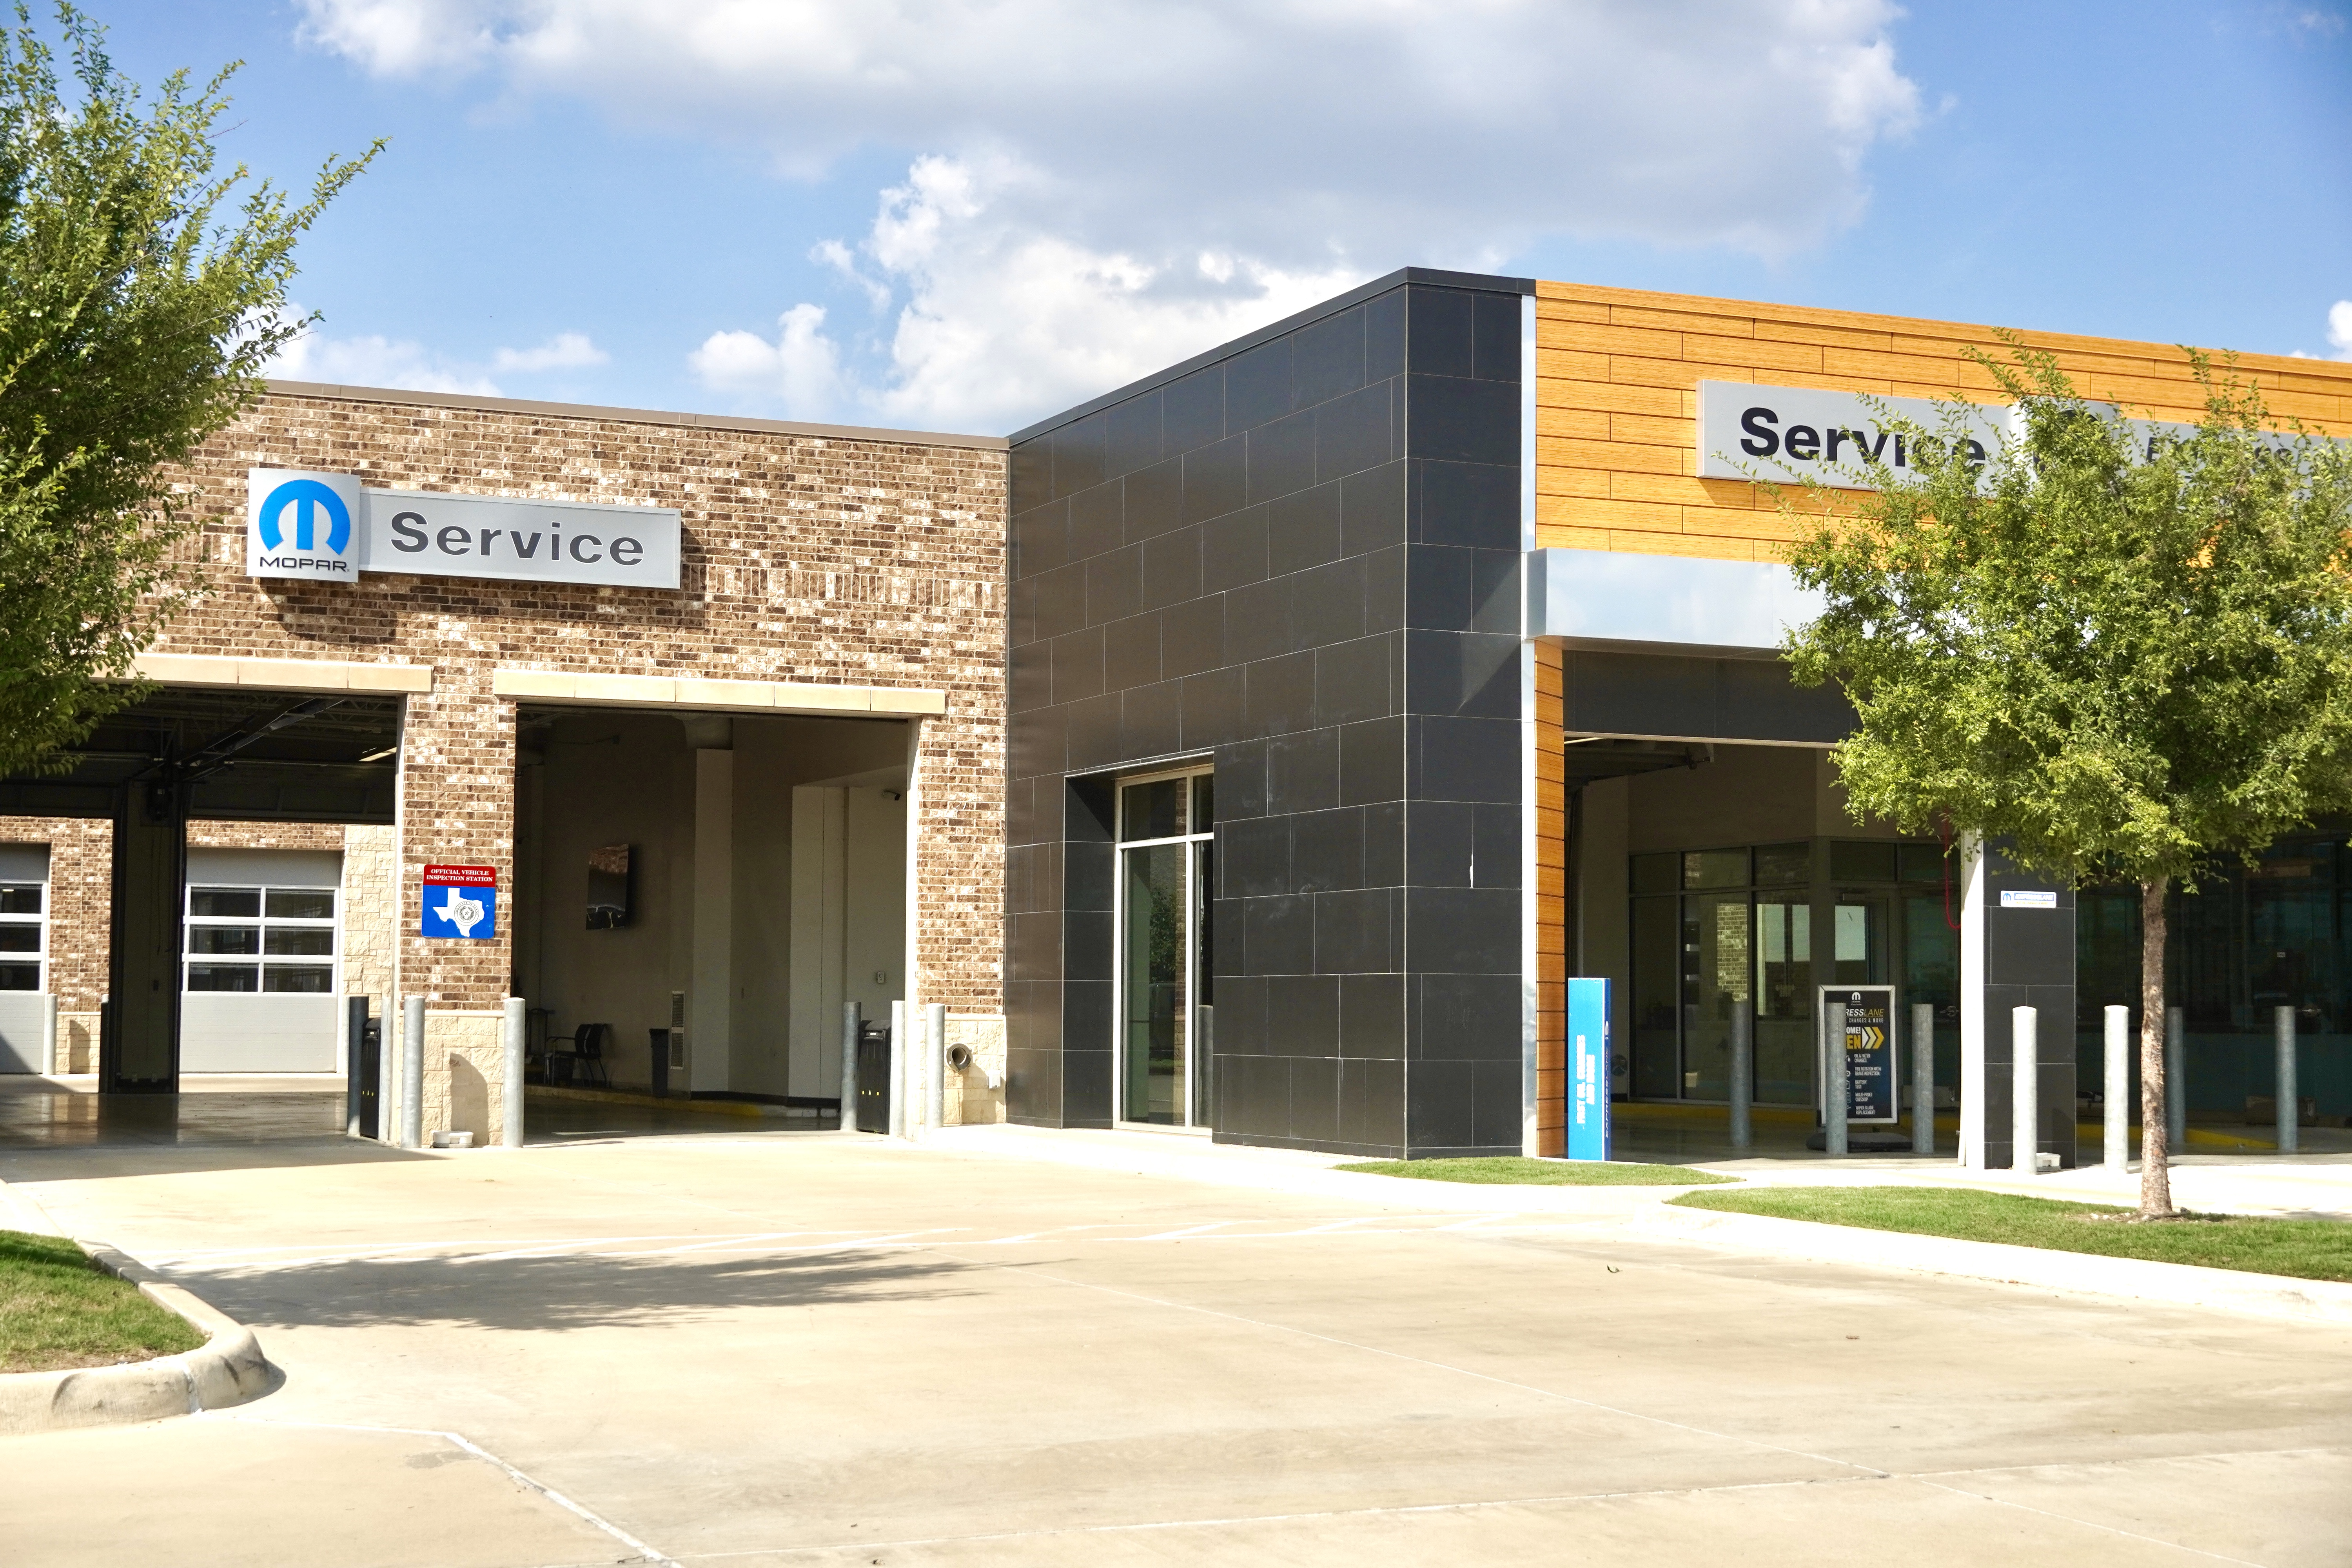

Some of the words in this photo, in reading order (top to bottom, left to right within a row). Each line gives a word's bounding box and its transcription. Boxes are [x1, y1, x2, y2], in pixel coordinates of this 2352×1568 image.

[391, 511, 644, 566] Service
[260, 557, 347, 572] MOPAR
[1846, 1035, 1861, 1049] EN
[1576, 1035, 1585, 1079] CHANGES
[1576, 1099, 1585, 1123] FAST
